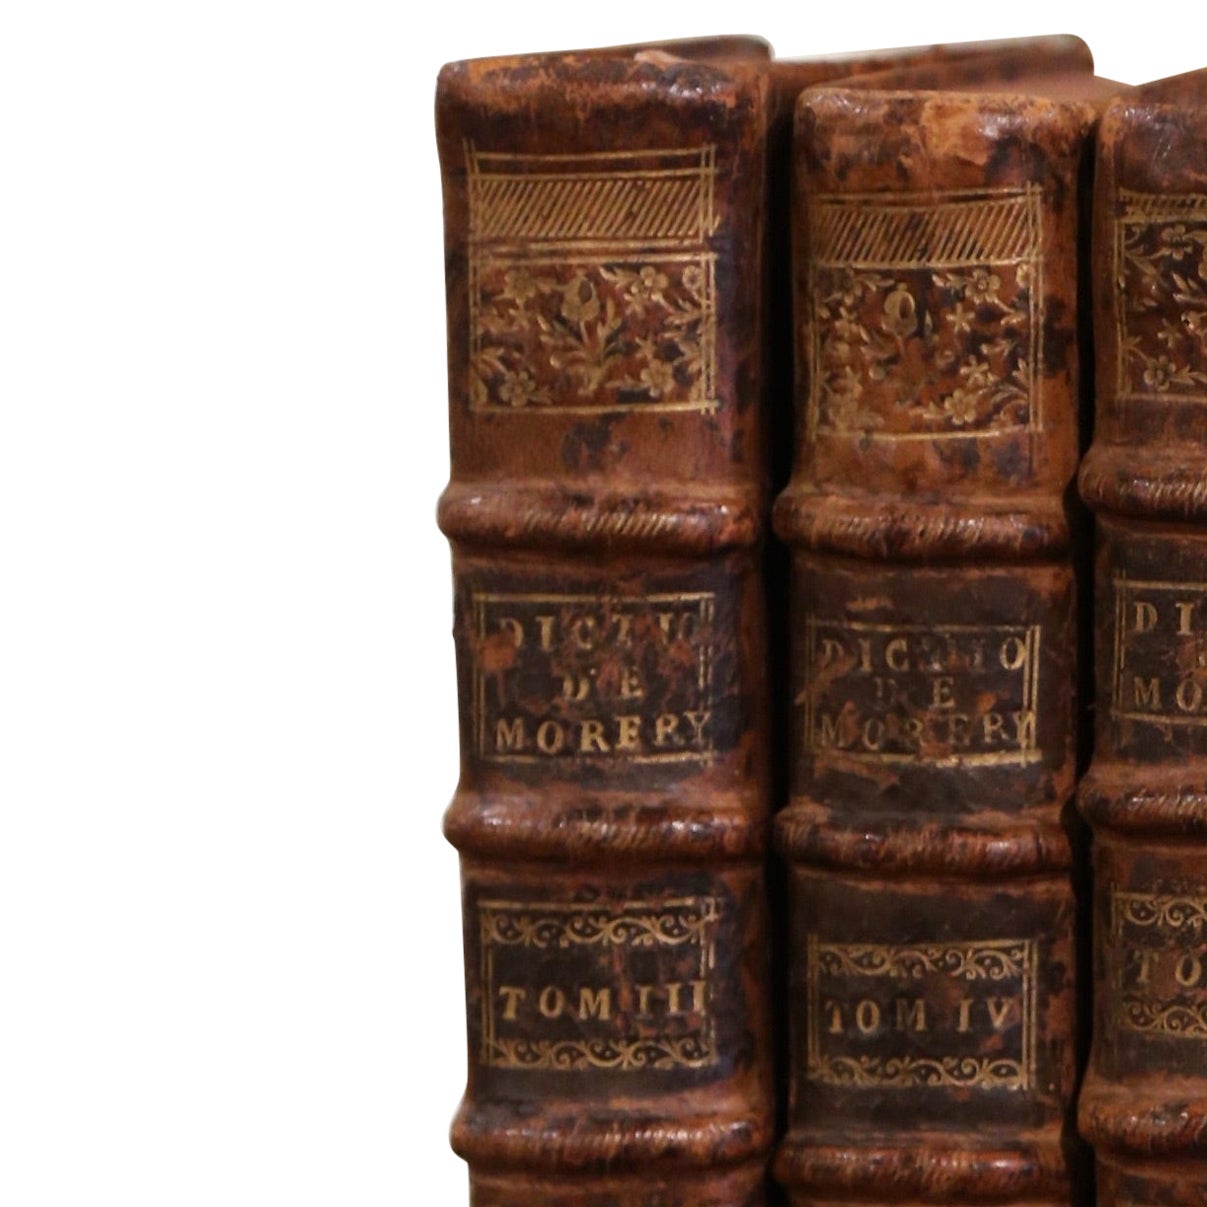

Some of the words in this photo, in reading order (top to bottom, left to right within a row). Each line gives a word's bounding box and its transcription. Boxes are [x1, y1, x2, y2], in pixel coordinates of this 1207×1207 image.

[495, 710, 712, 755] MORERY
[499, 985, 611, 1020] TOM
[637, 980, 706, 1015] III
[825, 999, 928, 1034] TOM
[956, 998, 1014, 1032] IV
